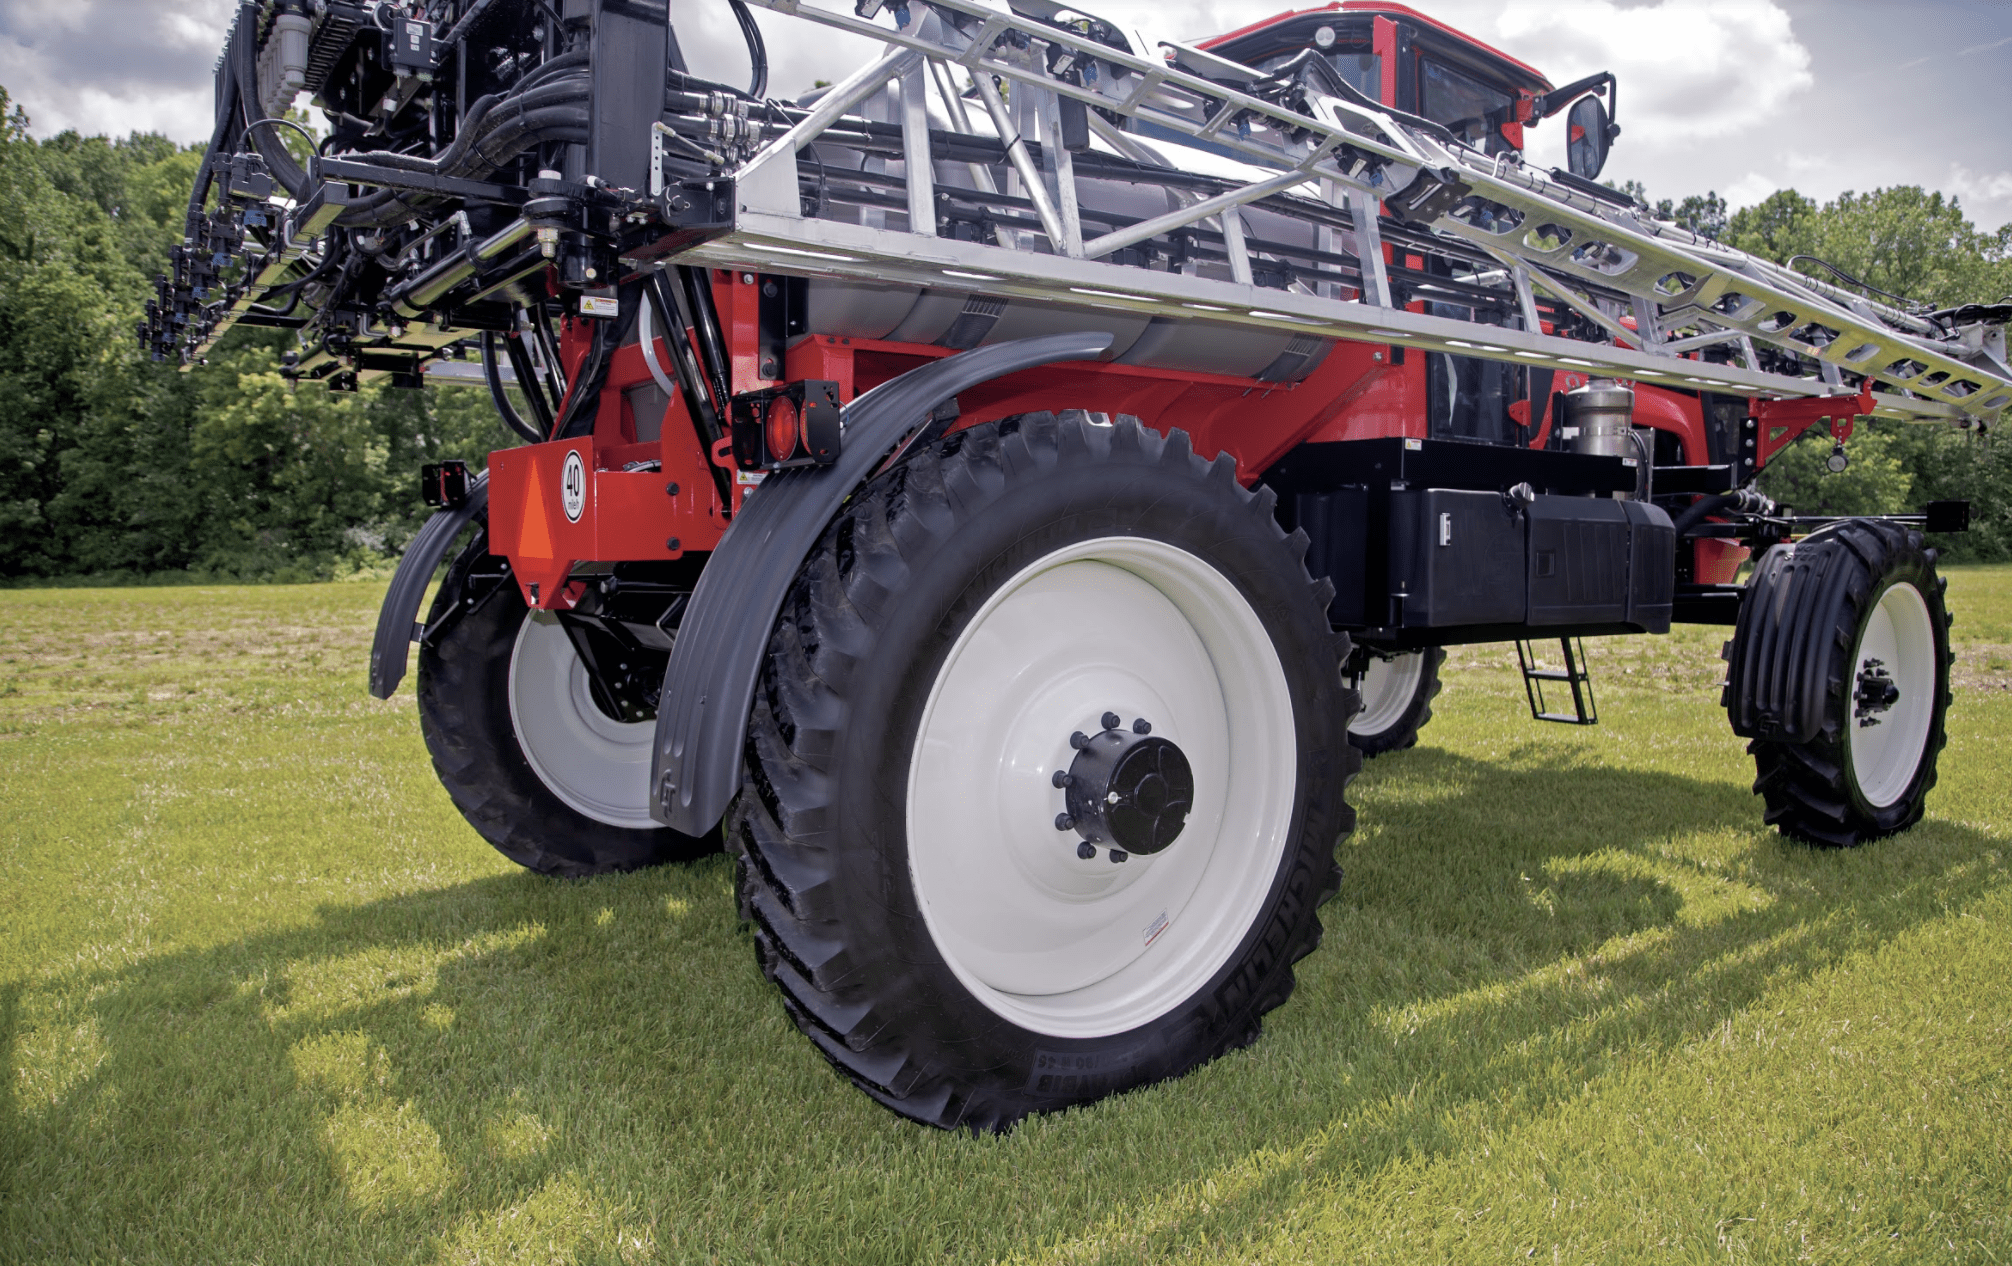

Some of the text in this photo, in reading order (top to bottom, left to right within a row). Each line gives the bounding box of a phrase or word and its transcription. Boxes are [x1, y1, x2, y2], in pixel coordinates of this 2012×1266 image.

[567, 464, 580, 497] 40
[1784, 552, 1817, 561] STEP
[1222, 806, 1329, 1012] MICHELIN
